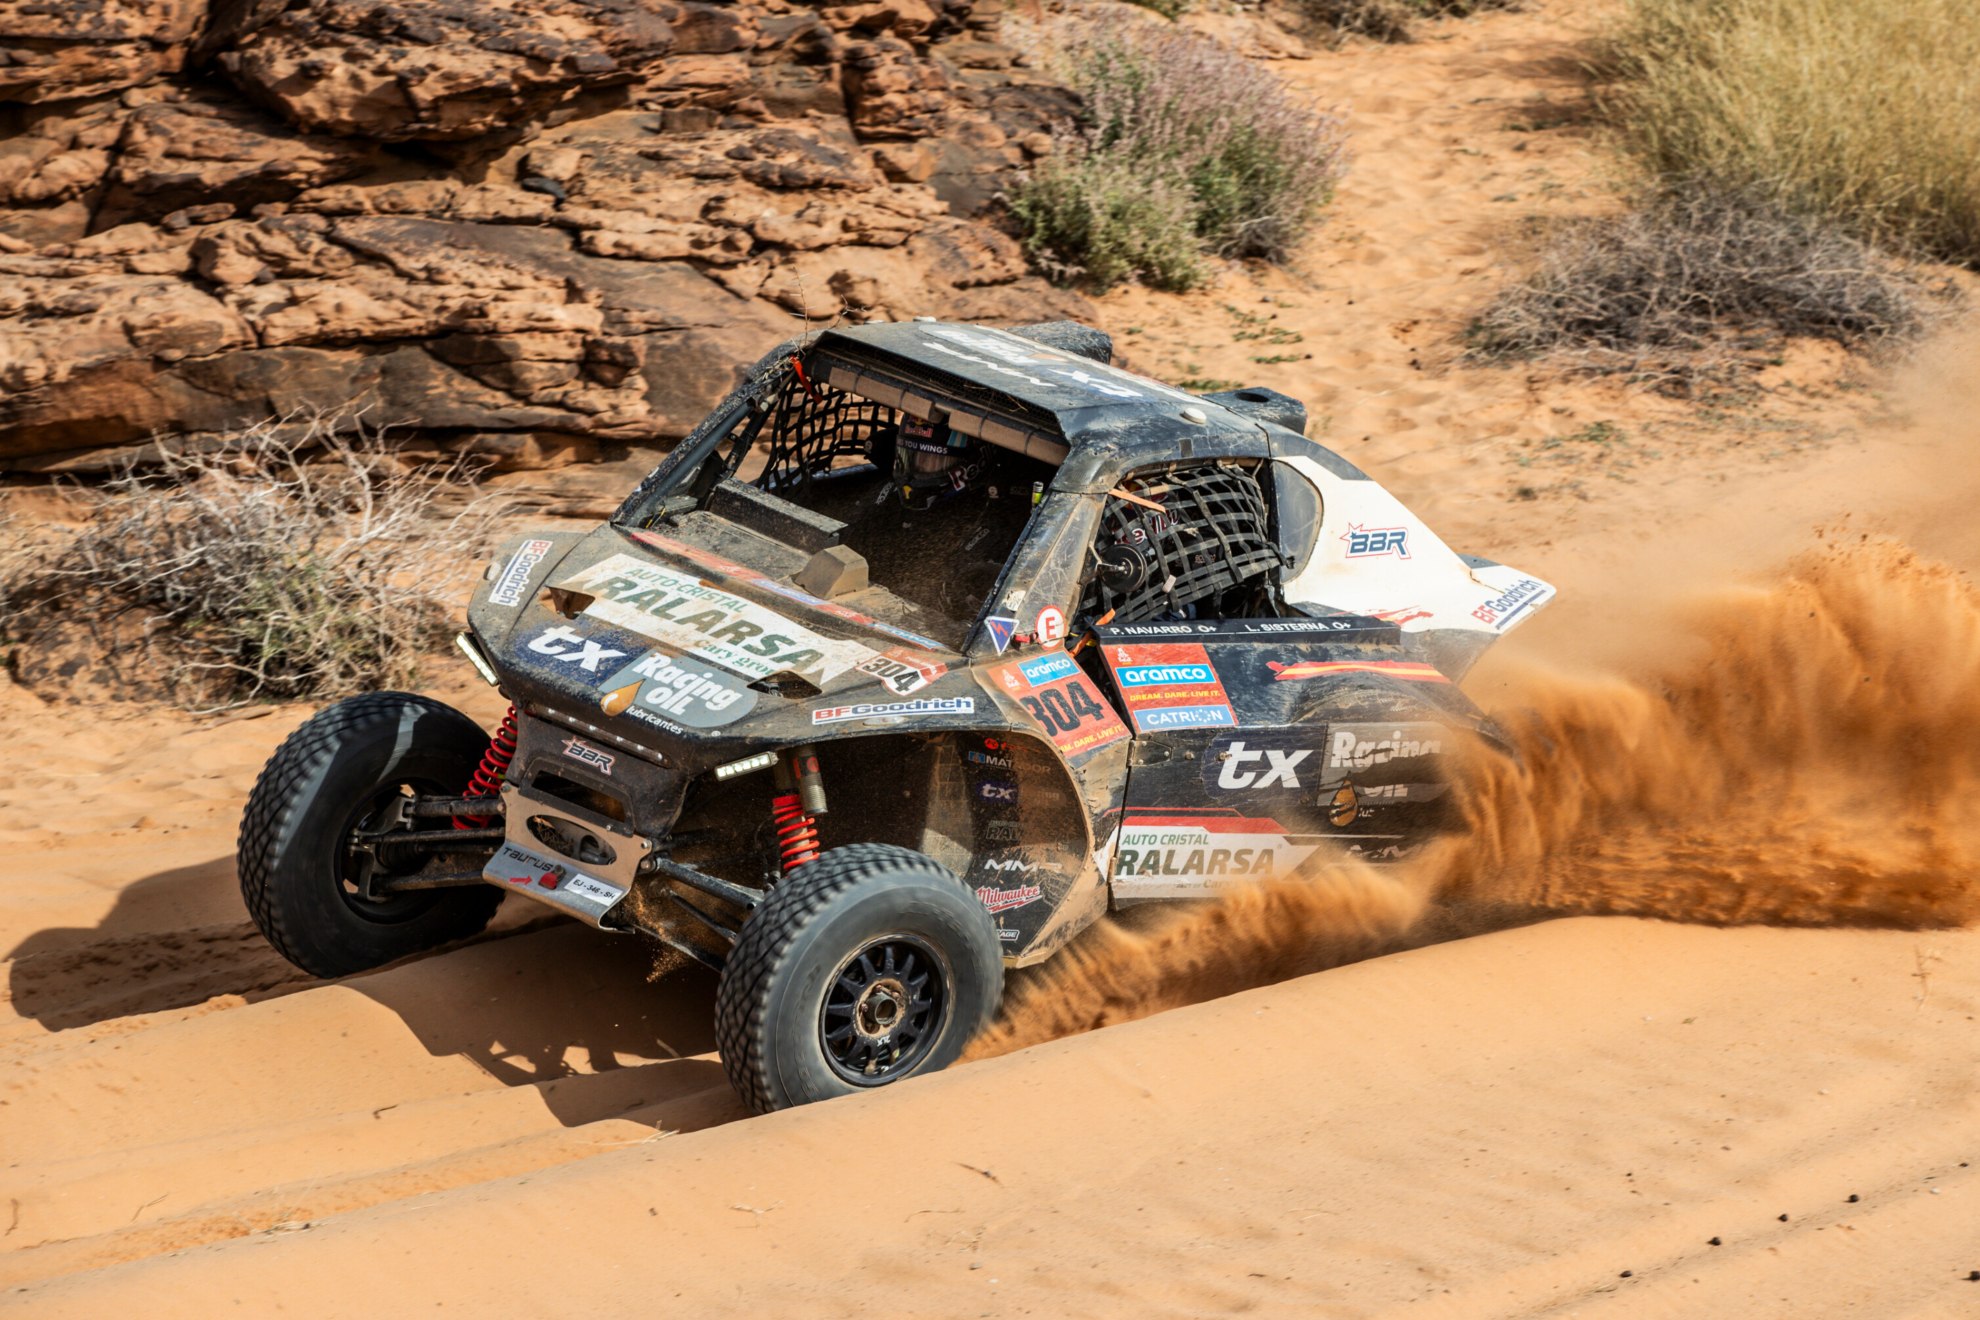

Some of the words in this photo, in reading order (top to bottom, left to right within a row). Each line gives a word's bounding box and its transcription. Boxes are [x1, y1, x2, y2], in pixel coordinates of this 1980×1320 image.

[919, 443, 948, 455] WINGS
[1350, 530, 1407, 556] BBR
[499, 541, 549, 604] BFGoodrich
[625, 566, 679, 589] AUTO
[676, 583, 750, 613] CRISTAL
[1471, 579, 1541, 624] BFGoodrich
[587, 575, 825, 674] RALARSA
[1045, 616, 1056, 640] E
[1126, 625, 1192, 635] NAVARRO
[1260, 622, 1330, 631] SISTERNA
[527, 624, 627, 672] tx
[732, 656, 777, 676] grou
[863, 658, 921, 693] 304
[1026, 658, 1071, 679] aramco
[1125, 667, 1207, 683] aramco
[632, 652, 743, 711] Racing
[815, 698, 972, 720] BFGoodrich
[1019, 681, 1104, 737] 304
[1129, 692, 1164, 702] DREAM.
[1191, 690, 1209, 698] LIVE
[625, 705, 684, 735] lubricantes
[569, 744, 616, 773] BBR
[1217, 741, 1314, 789] tx
[982, 783, 1017, 800] tx
[1122, 834, 1157, 845] AUTO
[1159, 834, 1209, 845] CRISTAL
[1115, 849, 1274, 876] RALARSA
[977, 884, 1041, 904] Milwaukee
